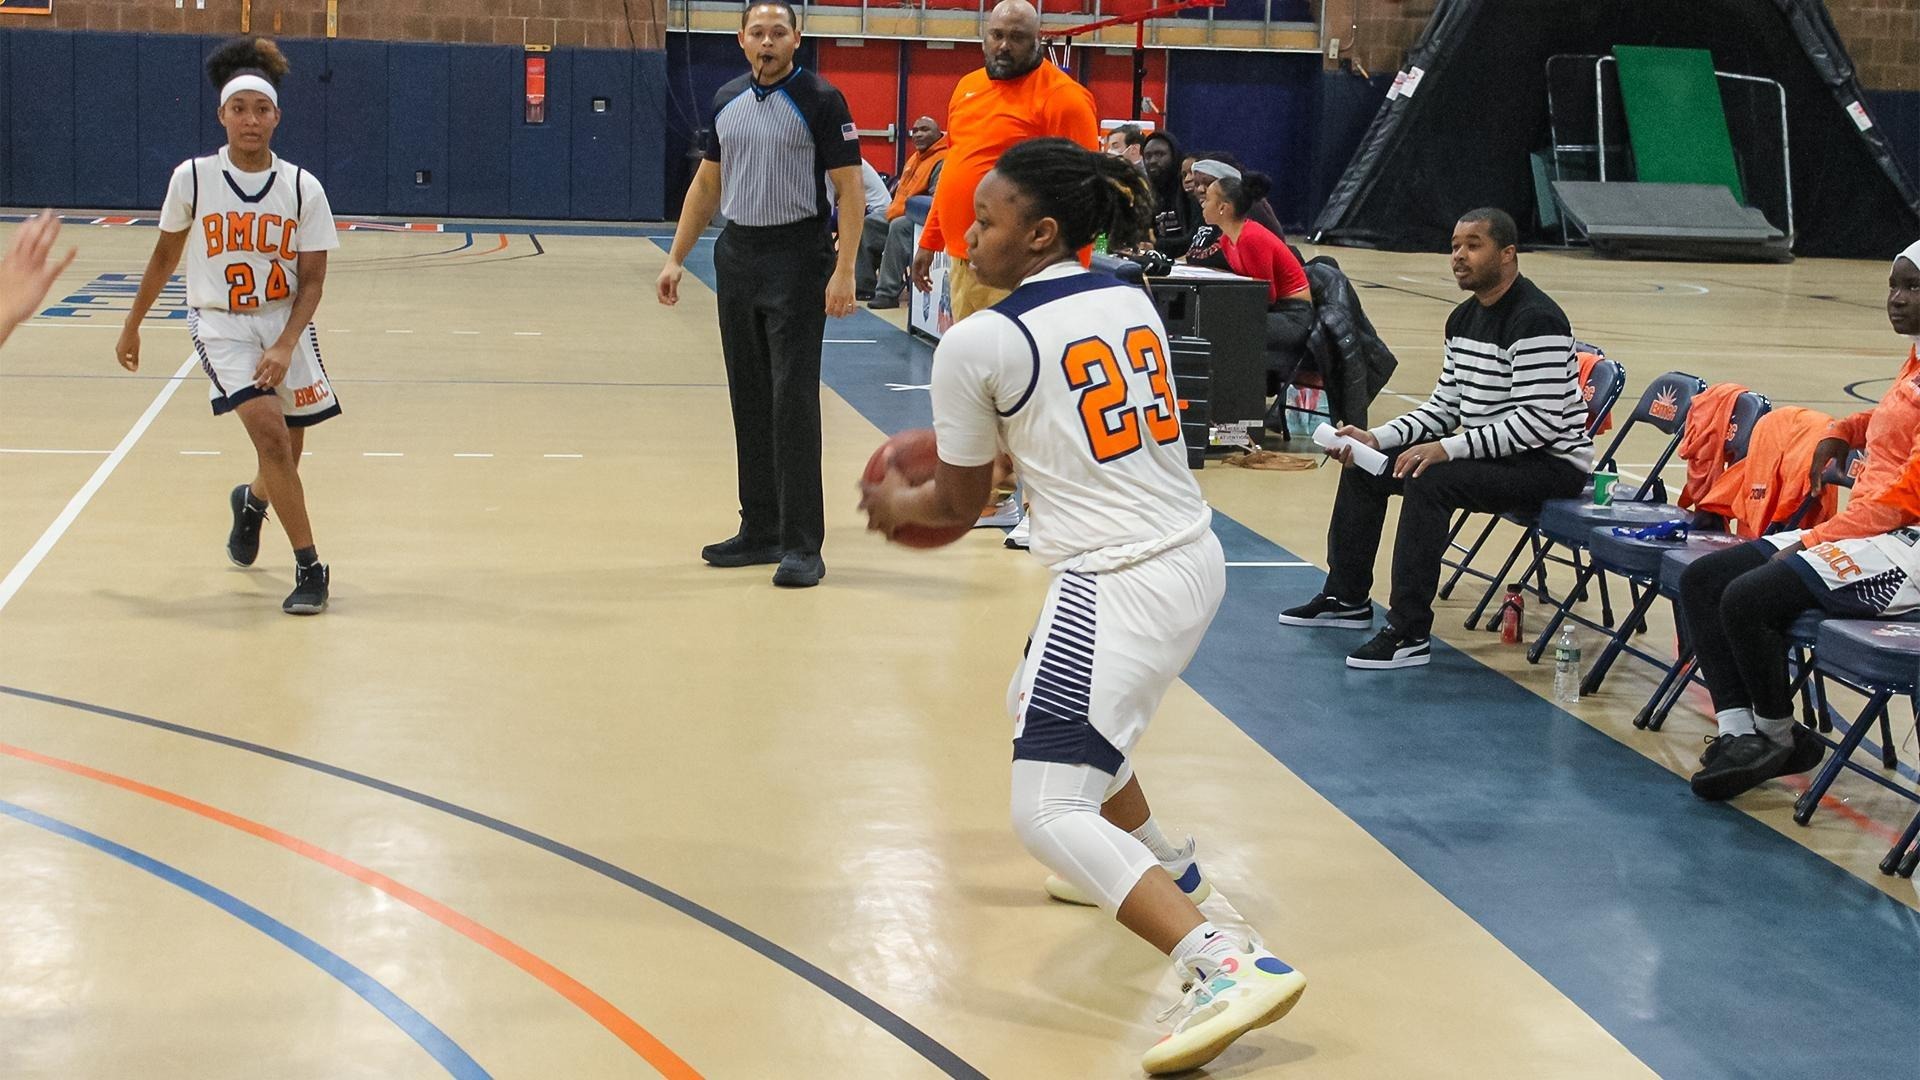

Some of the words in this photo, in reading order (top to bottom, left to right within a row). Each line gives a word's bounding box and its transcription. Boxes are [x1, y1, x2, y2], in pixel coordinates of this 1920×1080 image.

[202, 211, 298, 260] BMCC
[224, 258, 290, 314] 24
[294, 379, 329, 407] BMCC
[1060, 324, 1180, 464] 23
[1809, 543, 1863, 581] BMCC
